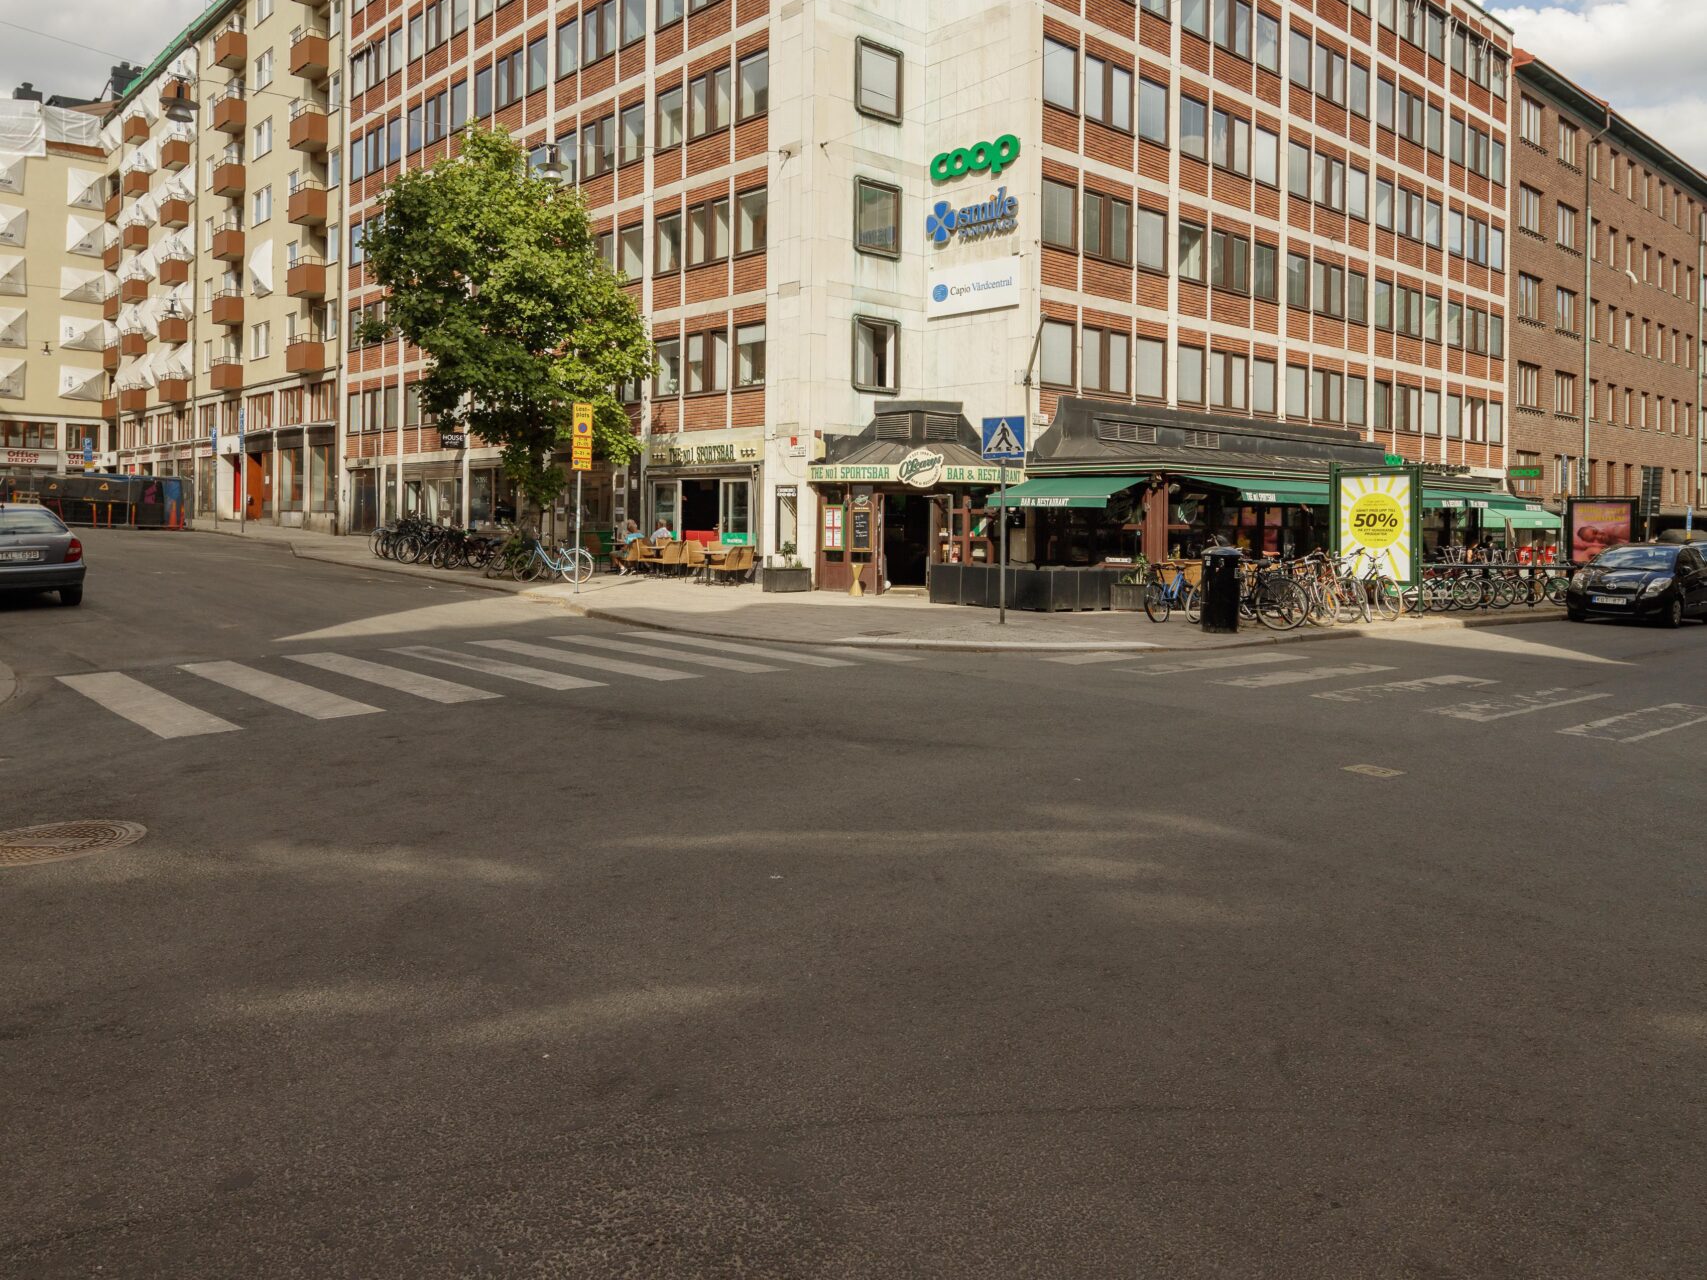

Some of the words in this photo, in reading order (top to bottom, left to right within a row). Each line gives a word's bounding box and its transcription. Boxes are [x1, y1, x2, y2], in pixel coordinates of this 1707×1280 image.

[930, 134, 1020, 180] coop
[958, 186, 1018, 227] smile
[950, 285, 971, 297] Capio
[972, 276, 1013, 291] Vårdcentral
[7, 450, 40, 459] Office
[696, 444, 734, 462] SPORTSBAR
[810, 467, 823, 480] THE
[840, 466, 890, 480] SPORTSBAR
[946, 467, 965, 480] BAR
[966, 469, 975, 480] &
[977, 469, 1022, 483] RESTARANT
[1020, 497, 1031, 507] BAR
[1036, 497, 1070, 507] RESTAURANT
[1353, 513, 1398, 528] 50%
